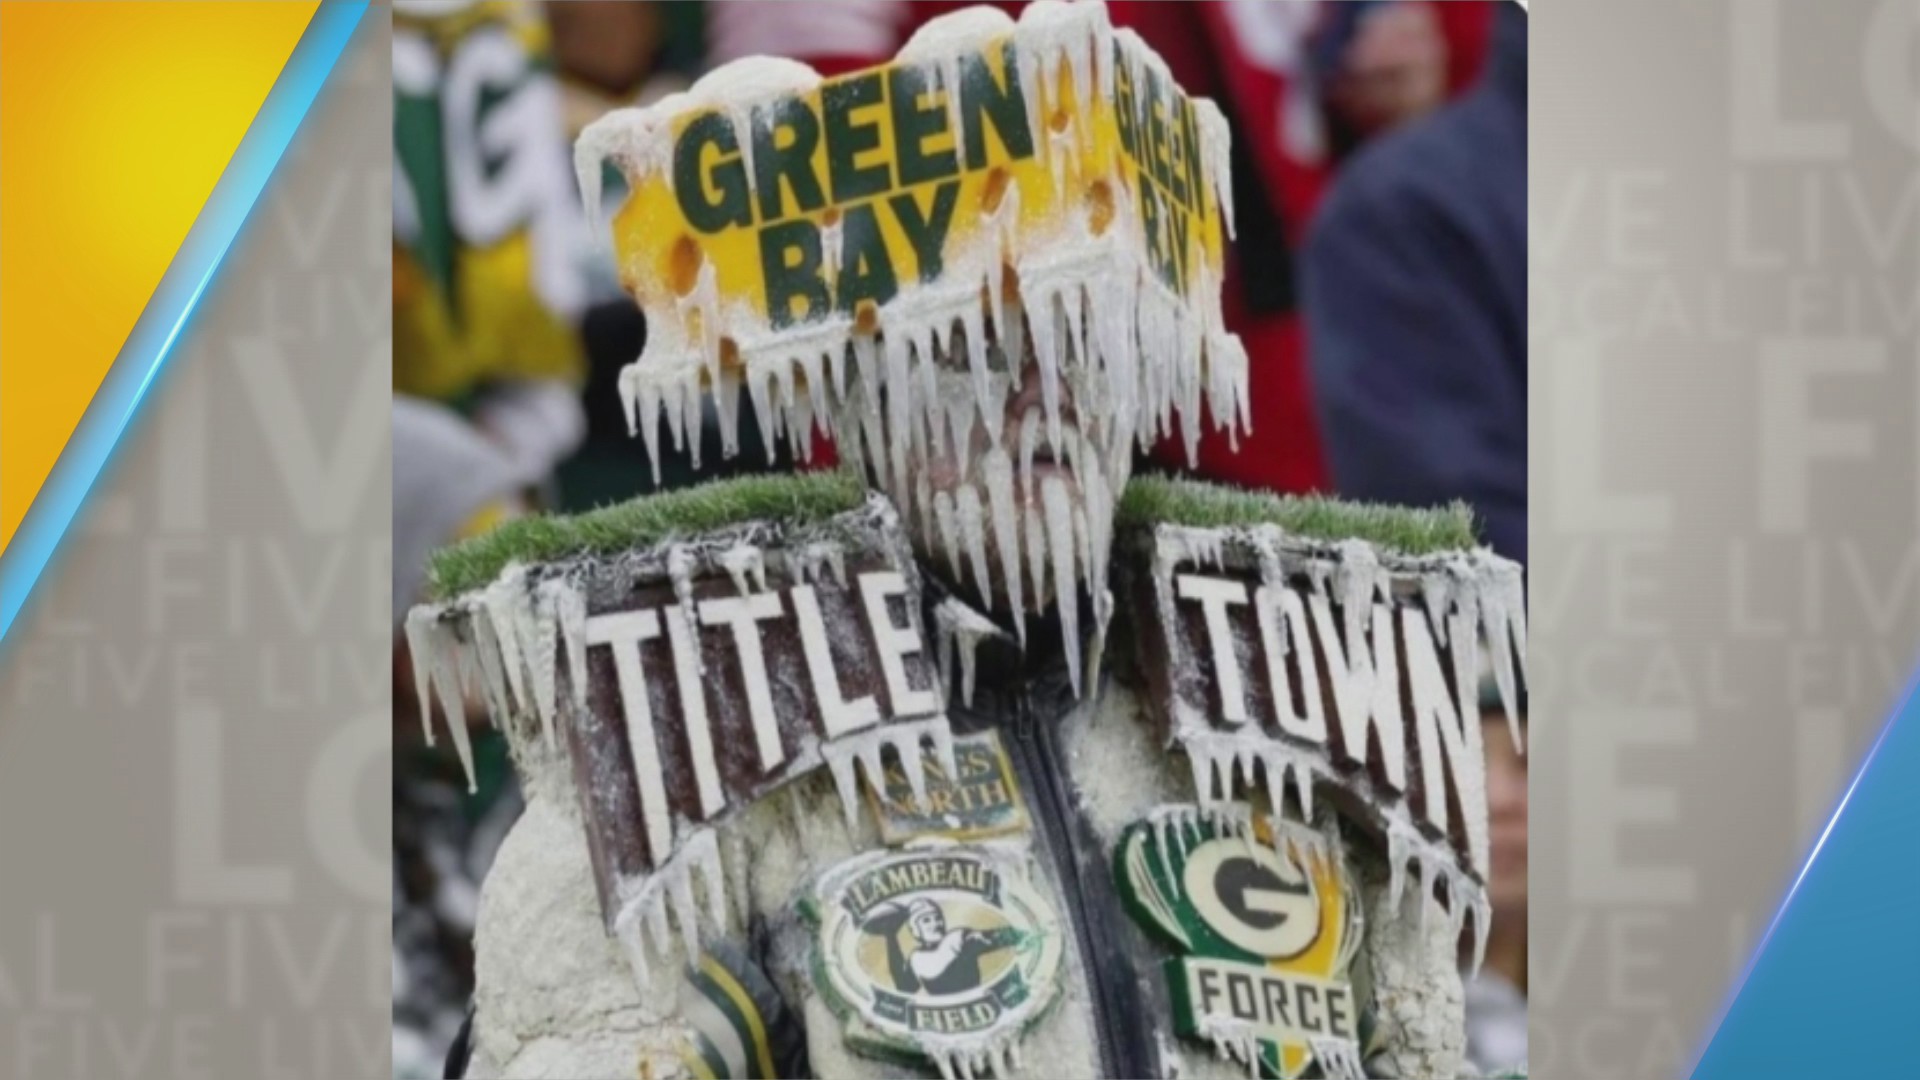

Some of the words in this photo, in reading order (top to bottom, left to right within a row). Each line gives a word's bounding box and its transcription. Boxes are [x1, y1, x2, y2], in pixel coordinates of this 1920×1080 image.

[672, 43, 1035, 234] GREEN
[758, 180, 961, 330] BAY
[585, 571, 936, 867] TITLE
[1178, 573, 1489, 881] TOWN
[853, 860, 986, 910] LAMBEAU
[915, 1002, 995, 1032] FIELD
[1197, 968, 1349, 1039] FORCE
